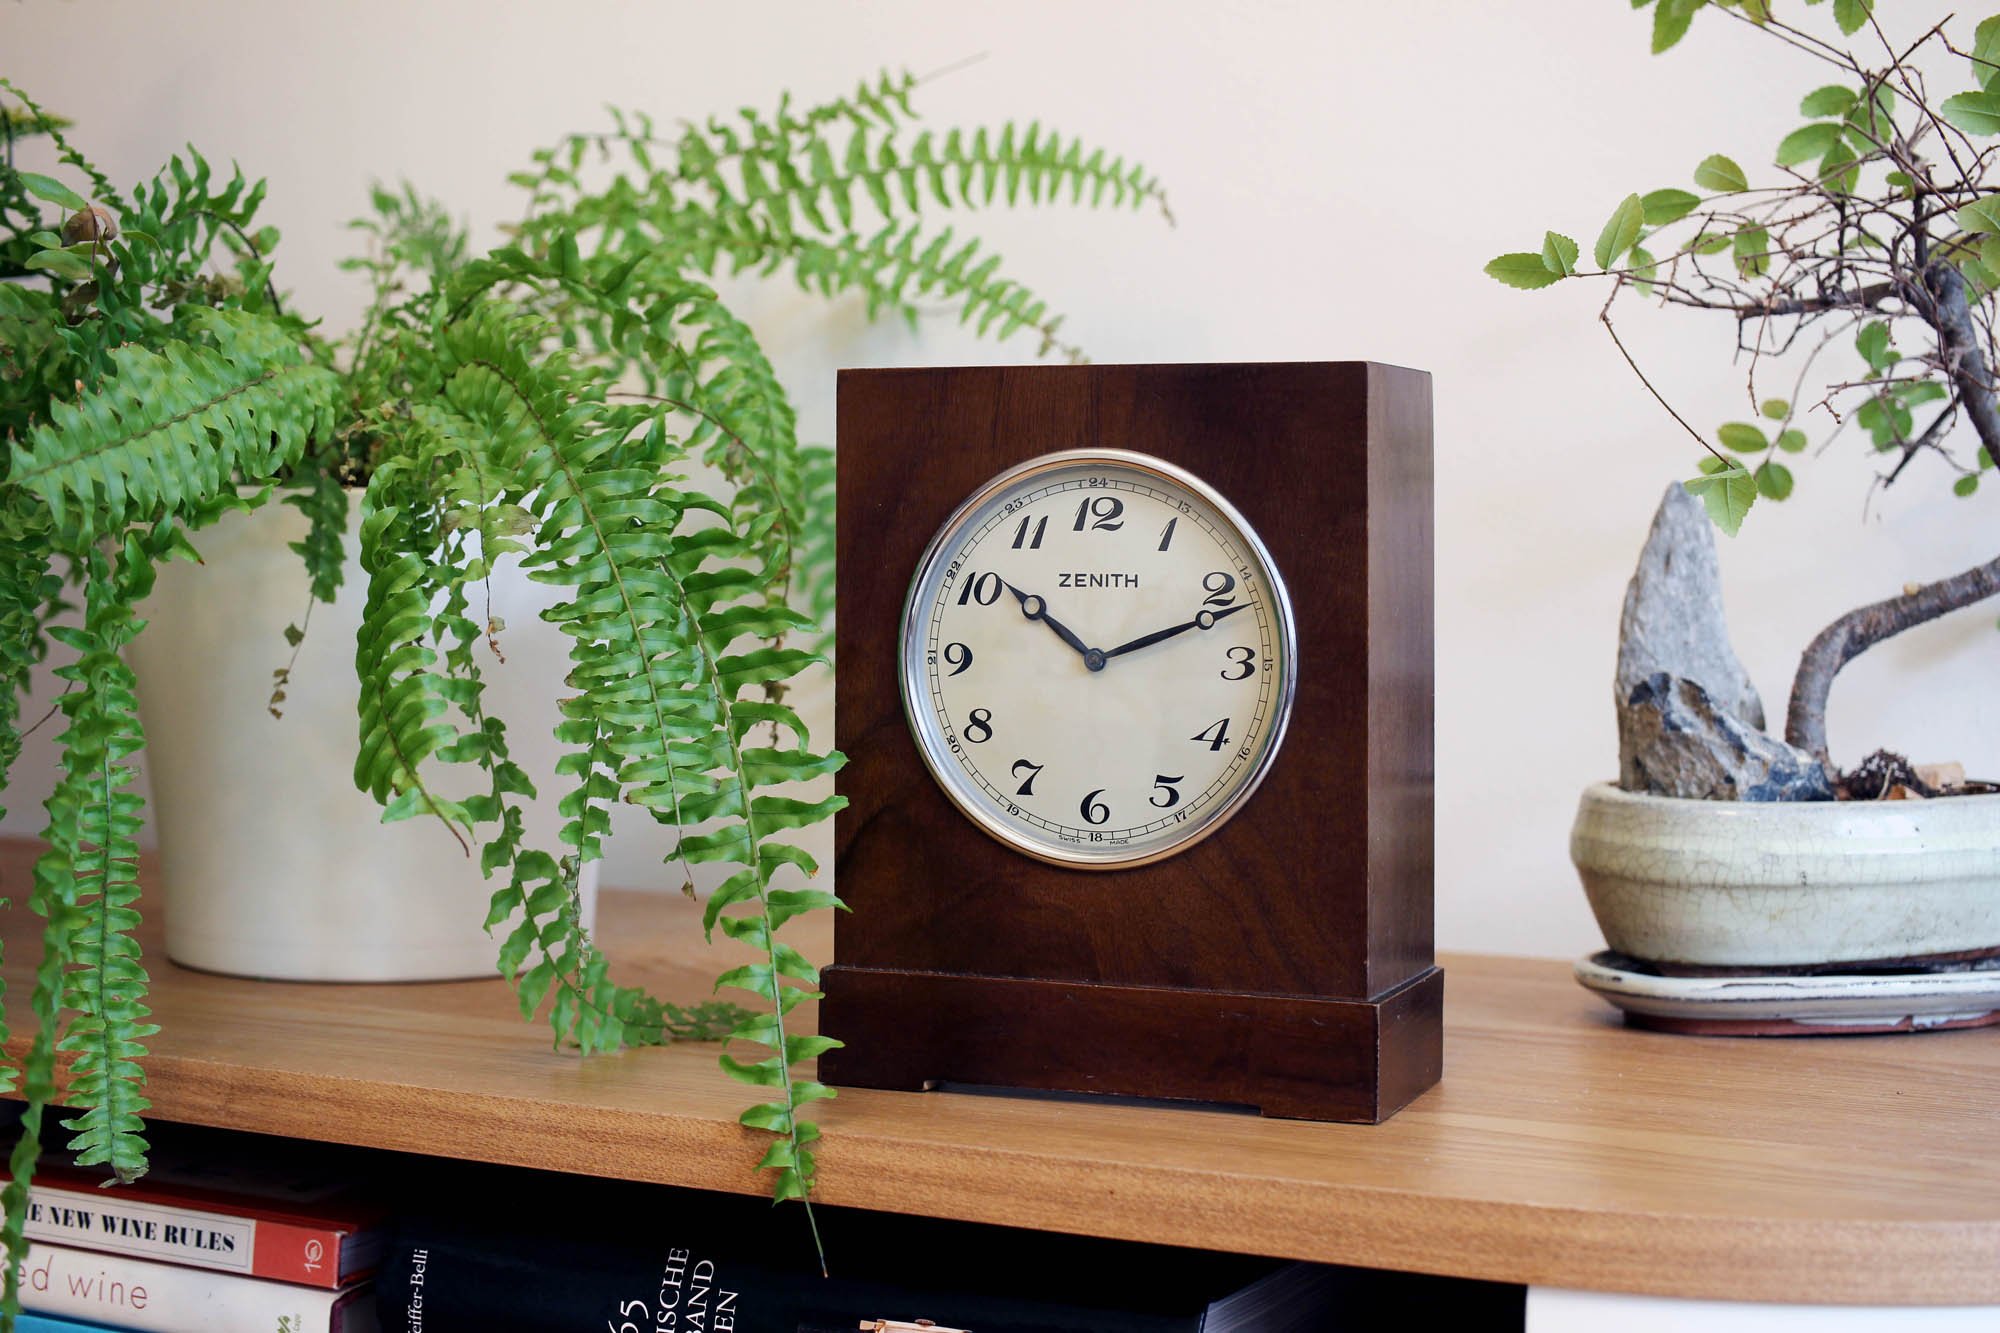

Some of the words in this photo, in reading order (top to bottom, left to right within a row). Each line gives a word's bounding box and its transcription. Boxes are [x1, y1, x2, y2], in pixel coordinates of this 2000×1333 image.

[1088, 477, 1108, 488] 24
[1004, 497, 1023, 514] 23
[1073, 496, 1124, 532] 12
[1177, 500, 1192, 514] 13
[1011, 515, 1049, 549] 11
[1158, 516, 1178, 551] 1
[946, 560, 961, 580] 22
[1058, 573, 1139, 588] ZENITH
[1239, 565, 1252, 581] 14
[957, 571, 1003, 606] 10
[1202, 571, 1236, 606] 2
[927, 650, 937, 665] 21
[944, 642, 973, 677] 9
[1220, 646, 1256, 681] 3
[1264, 657, 1273, 672] 15
[963, 708, 993, 743] 8
[1189, 718, 1230, 751] 4
[946, 735, 961, 754] 20
[1238, 747, 1251, 762] 16
[1011, 759, 1044, 796] 7
[1149, 774, 1184, 808] 5
[1005, 804, 1020, 817] 19
[1080, 788, 1110, 824] 6
[1173, 810, 1188, 823] 17
[1058, 834, 1081, 844] SWISS
[1109, 838, 1129, 846] MADE
[1087, 832, 1103, 842] 18
[49, 1206, 94, 1230] NEW
[101, 1214, 157, 1241] WINE
[164, 1225, 235, 1253] RULES
[68, 1271, 148, 1310] wine
